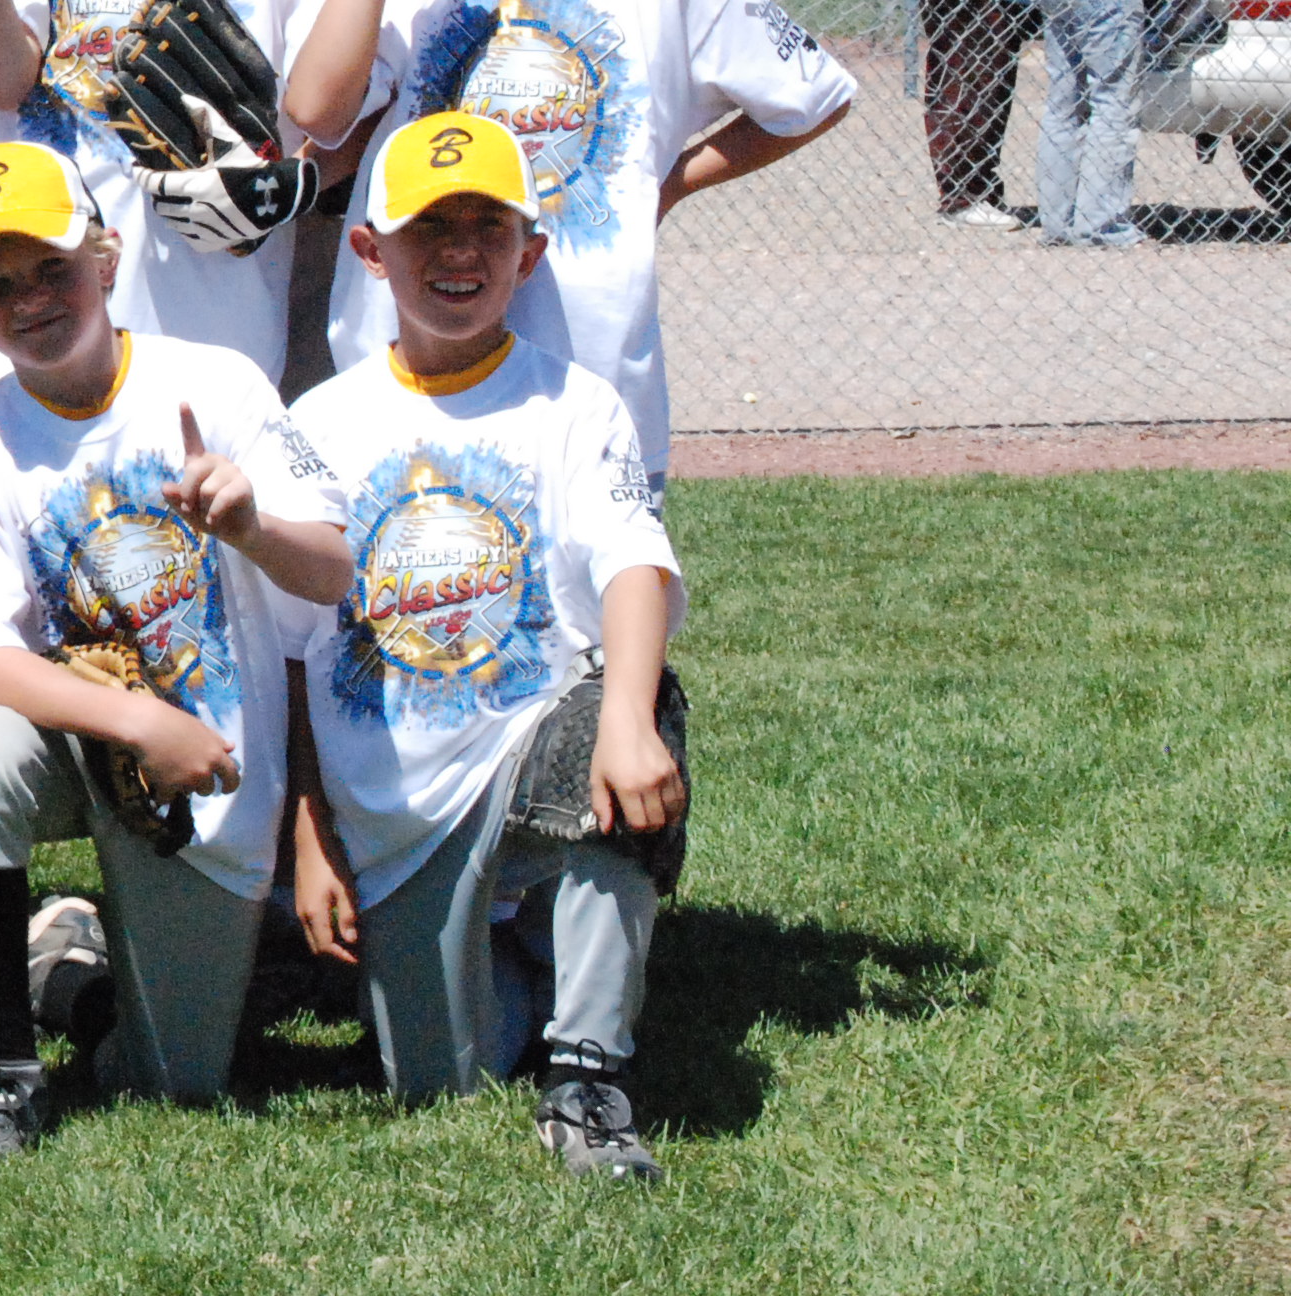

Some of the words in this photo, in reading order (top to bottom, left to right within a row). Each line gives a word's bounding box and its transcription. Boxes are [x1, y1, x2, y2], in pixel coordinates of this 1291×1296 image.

[542, 82, 581, 101] DAY
[430, 127, 472, 168] B
[154, 551, 187, 576] DAY
[378, 547, 460, 572] FATHER'S
[459, 545, 504, 568] DAY
[89, 561, 196, 636] Cassic
[370, 555, 513, 621] Classic
